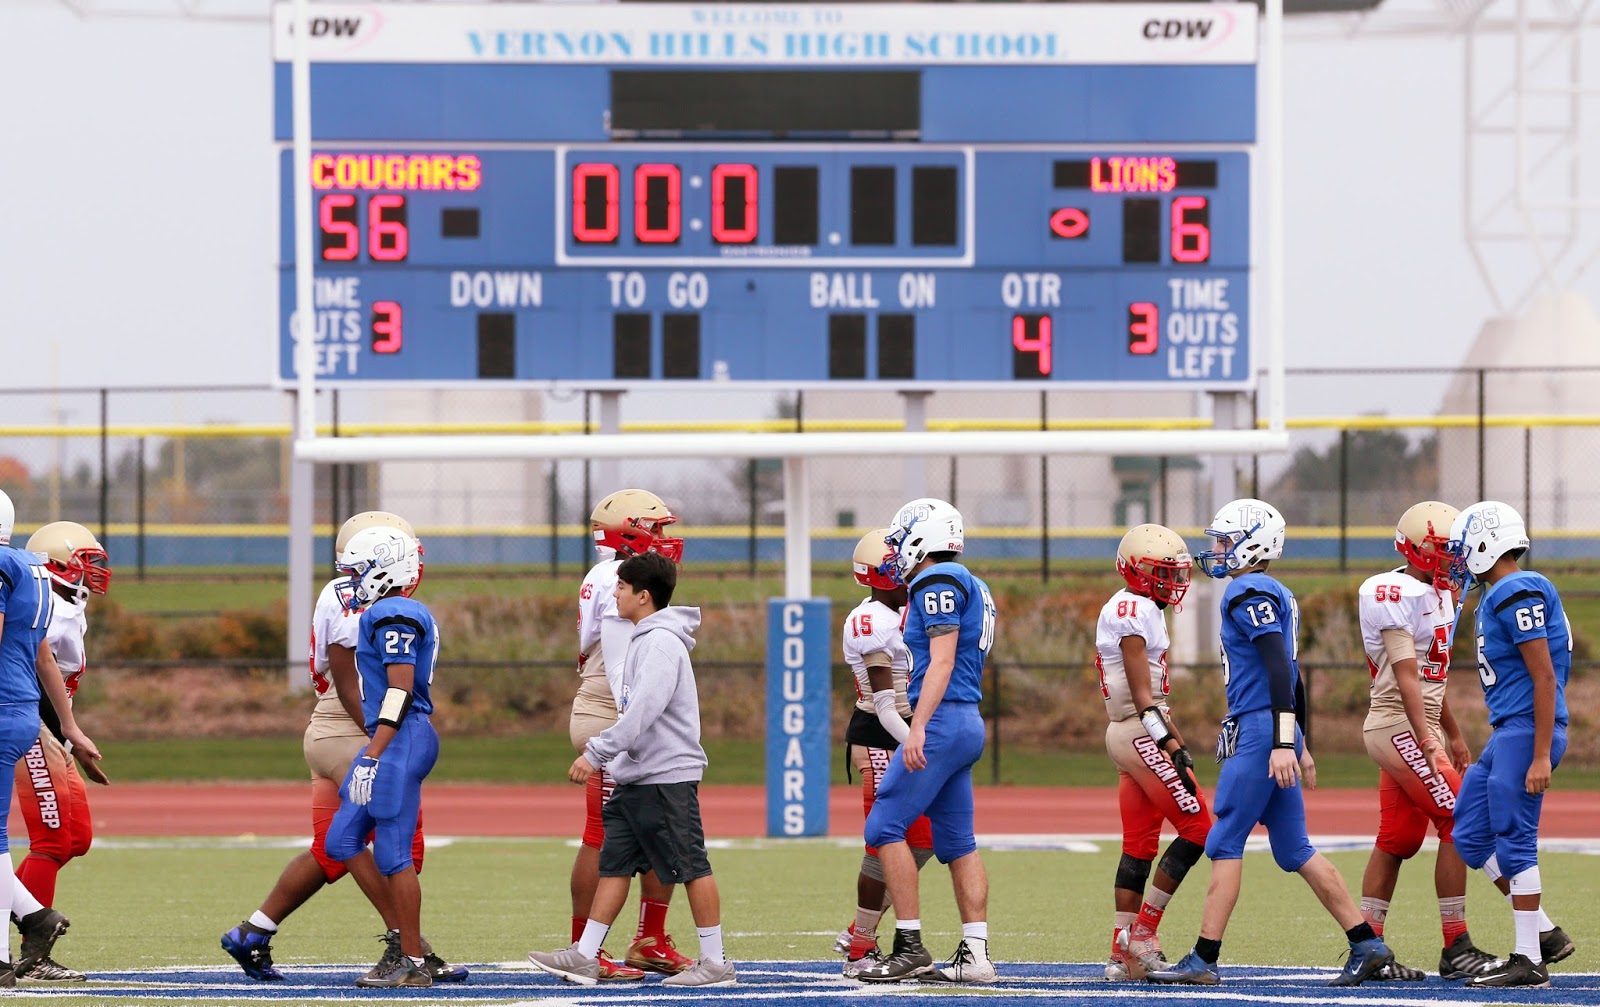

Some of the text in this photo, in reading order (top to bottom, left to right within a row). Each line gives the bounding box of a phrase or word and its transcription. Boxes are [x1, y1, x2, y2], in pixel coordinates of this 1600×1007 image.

[288, 18, 361, 37] DW
[691, 8, 842, 25] WELCOME TO
[1142, 18, 1214, 40] CDW
[466, 31, 1066, 58] VERNON HILLS HIGH SCHOOL
[311, 154, 481, 191] COUGARS
[1090, 157, 1177, 193] LIONS
[320, 194, 408, 262] 56
[1171, 196, 1210, 263] 6
[313, 277, 361, 309] IME
[451, 273, 542, 306] DOWN
[608, 273, 708, 307] TO GO
[811, 273, 935, 307] BALL ON
[1002, 274, 1061, 307] QTR
[1168, 279, 1228, 310] TIME
[372, 301, 403, 353] 3
[1130, 302, 1159, 355] 3
[1167, 313, 1238, 343] OUTS
[292, 342, 361, 375] EFT
[1013, 316, 1052, 375] 4
[1168, 346, 1236, 377] LEFT
[900, 503, 930, 526] 66
[1238, 506, 1266, 529] 13
[1469, 508, 1500, 534] 65
[373, 537, 406, 569] 27
[923, 590, 956, 615] 66
[1116, 600, 1138, 619] 81
[1375, 584, 1402, 603] 55
[851, 614, 874, 638] 15
[1246, 601, 1276, 627] 13
[1515, 603, 1546, 632] 65
[385, 630, 416, 655] 27
[783, 603, 805, 836] COUGARS
[1133, 735, 1178, 783] URBAN
[1391, 731, 1457, 811] URBAN PREP
[36, 790, 61, 830] PREP
